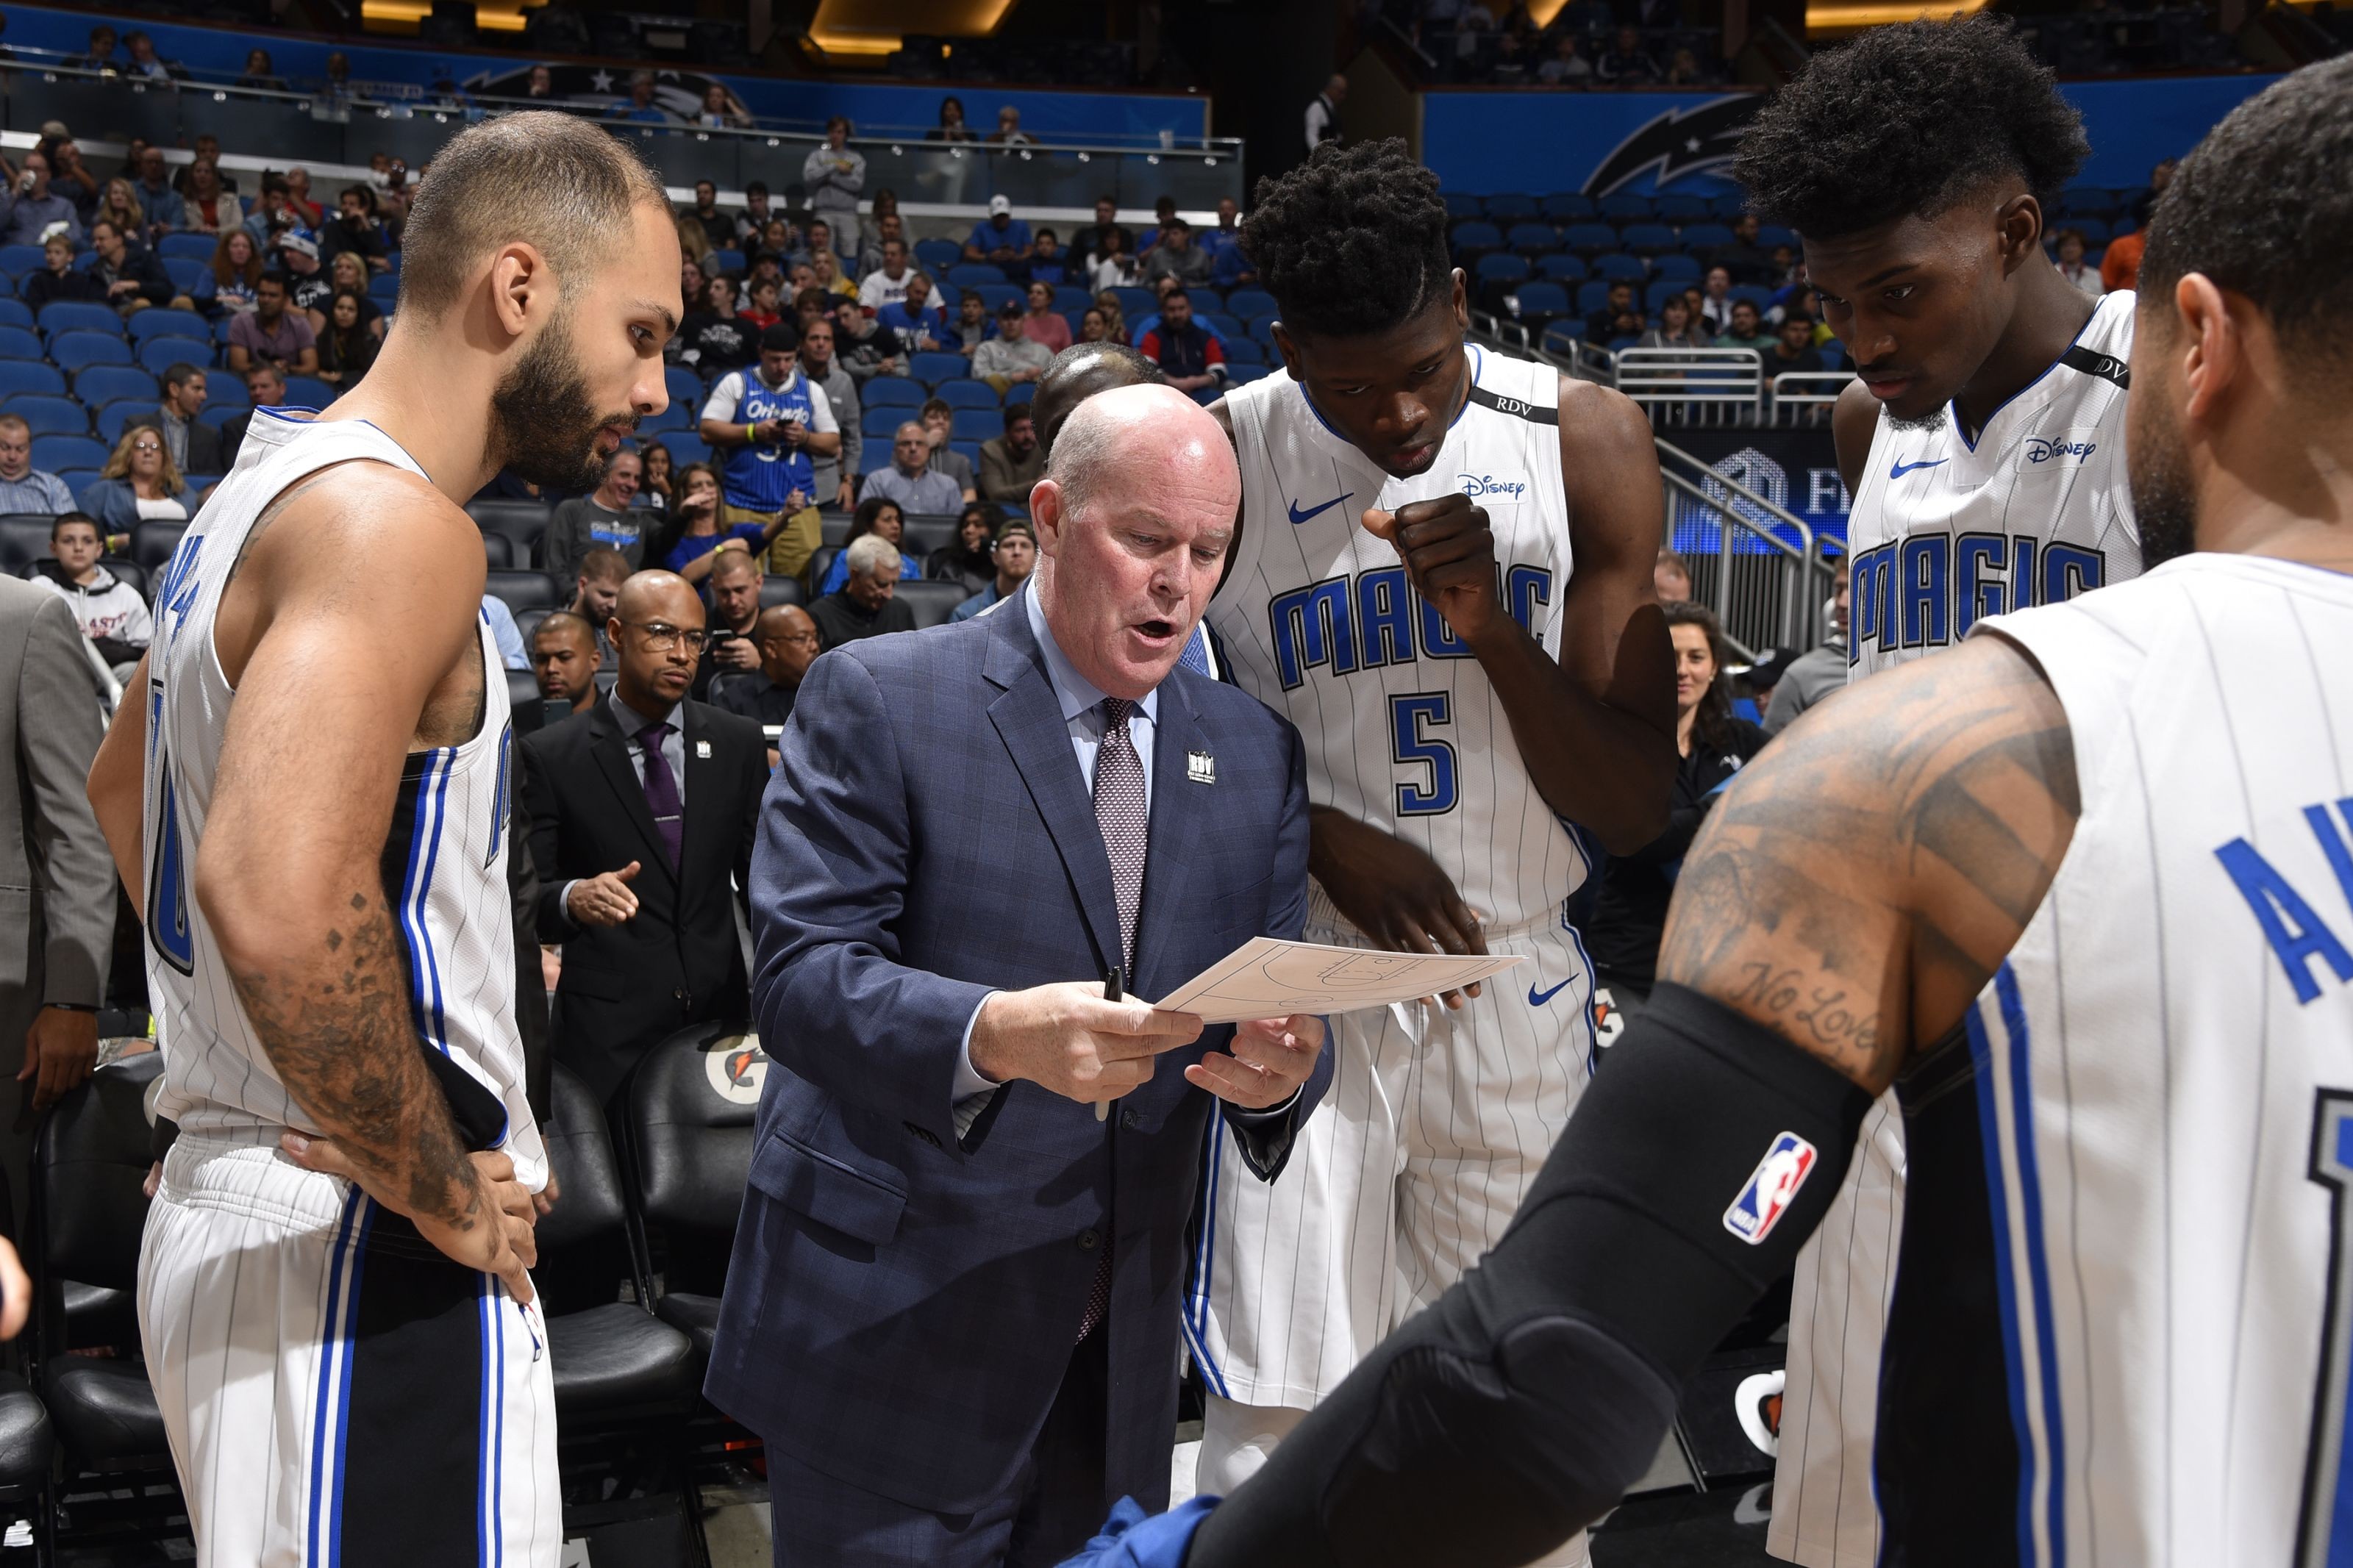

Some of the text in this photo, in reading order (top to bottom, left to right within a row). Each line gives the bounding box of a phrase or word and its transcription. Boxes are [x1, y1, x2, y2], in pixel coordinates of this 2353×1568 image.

[2095, 359, 2128, 379] DV
[1496, 397, 1532, 417] RDV
[2026, 437, 2096, 464] Disney
[1457, 474, 1525, 501] Disney
[1268, 562, 1552, 692] MAC
[1388, 690, 1459, 817] 5
[1730, 962, 1803, 1012] No
[1796, 988, 1880, 1049] Love
[1731, 1207, 1760, 1233] NBA
